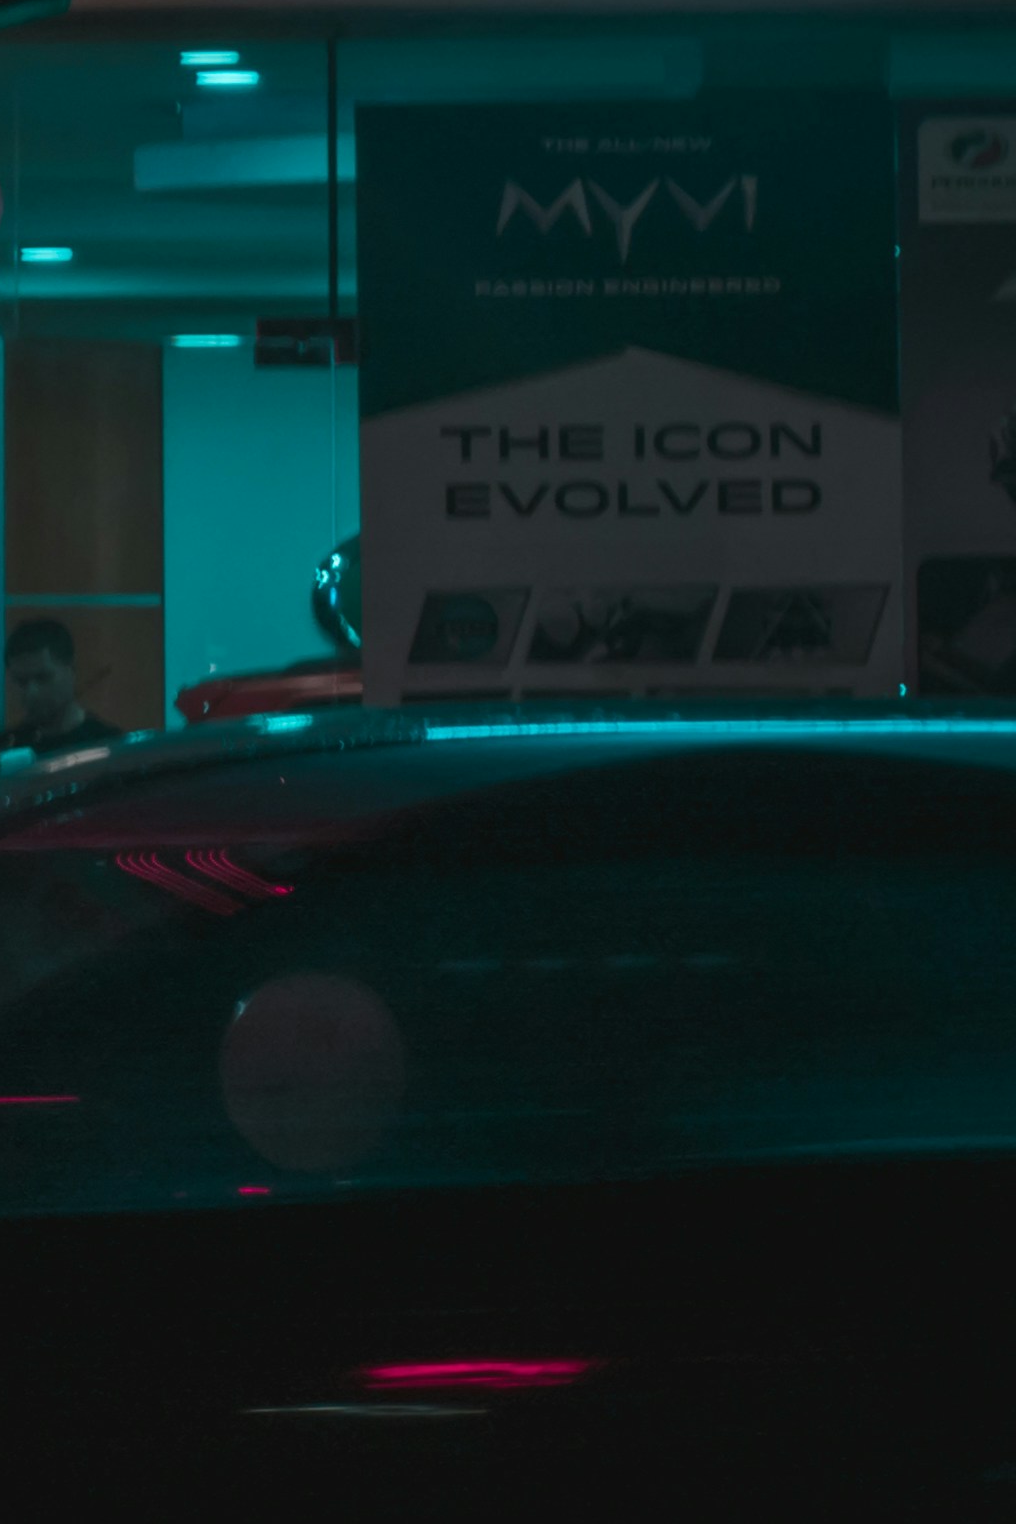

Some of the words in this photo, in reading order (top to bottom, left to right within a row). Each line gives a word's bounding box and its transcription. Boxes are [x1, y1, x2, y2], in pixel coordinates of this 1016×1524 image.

[539, 135, 591, 156] THE
[494, 173, 760, 268] MYVI
[474, 277, 595, 298] PASSION
[603, 275, 782, 297] ENGINEERED
[440, 423, 605, 462] THE
[633, 420, 823, 461] ICON
[444, 479, 823, 519] EVOLVED
